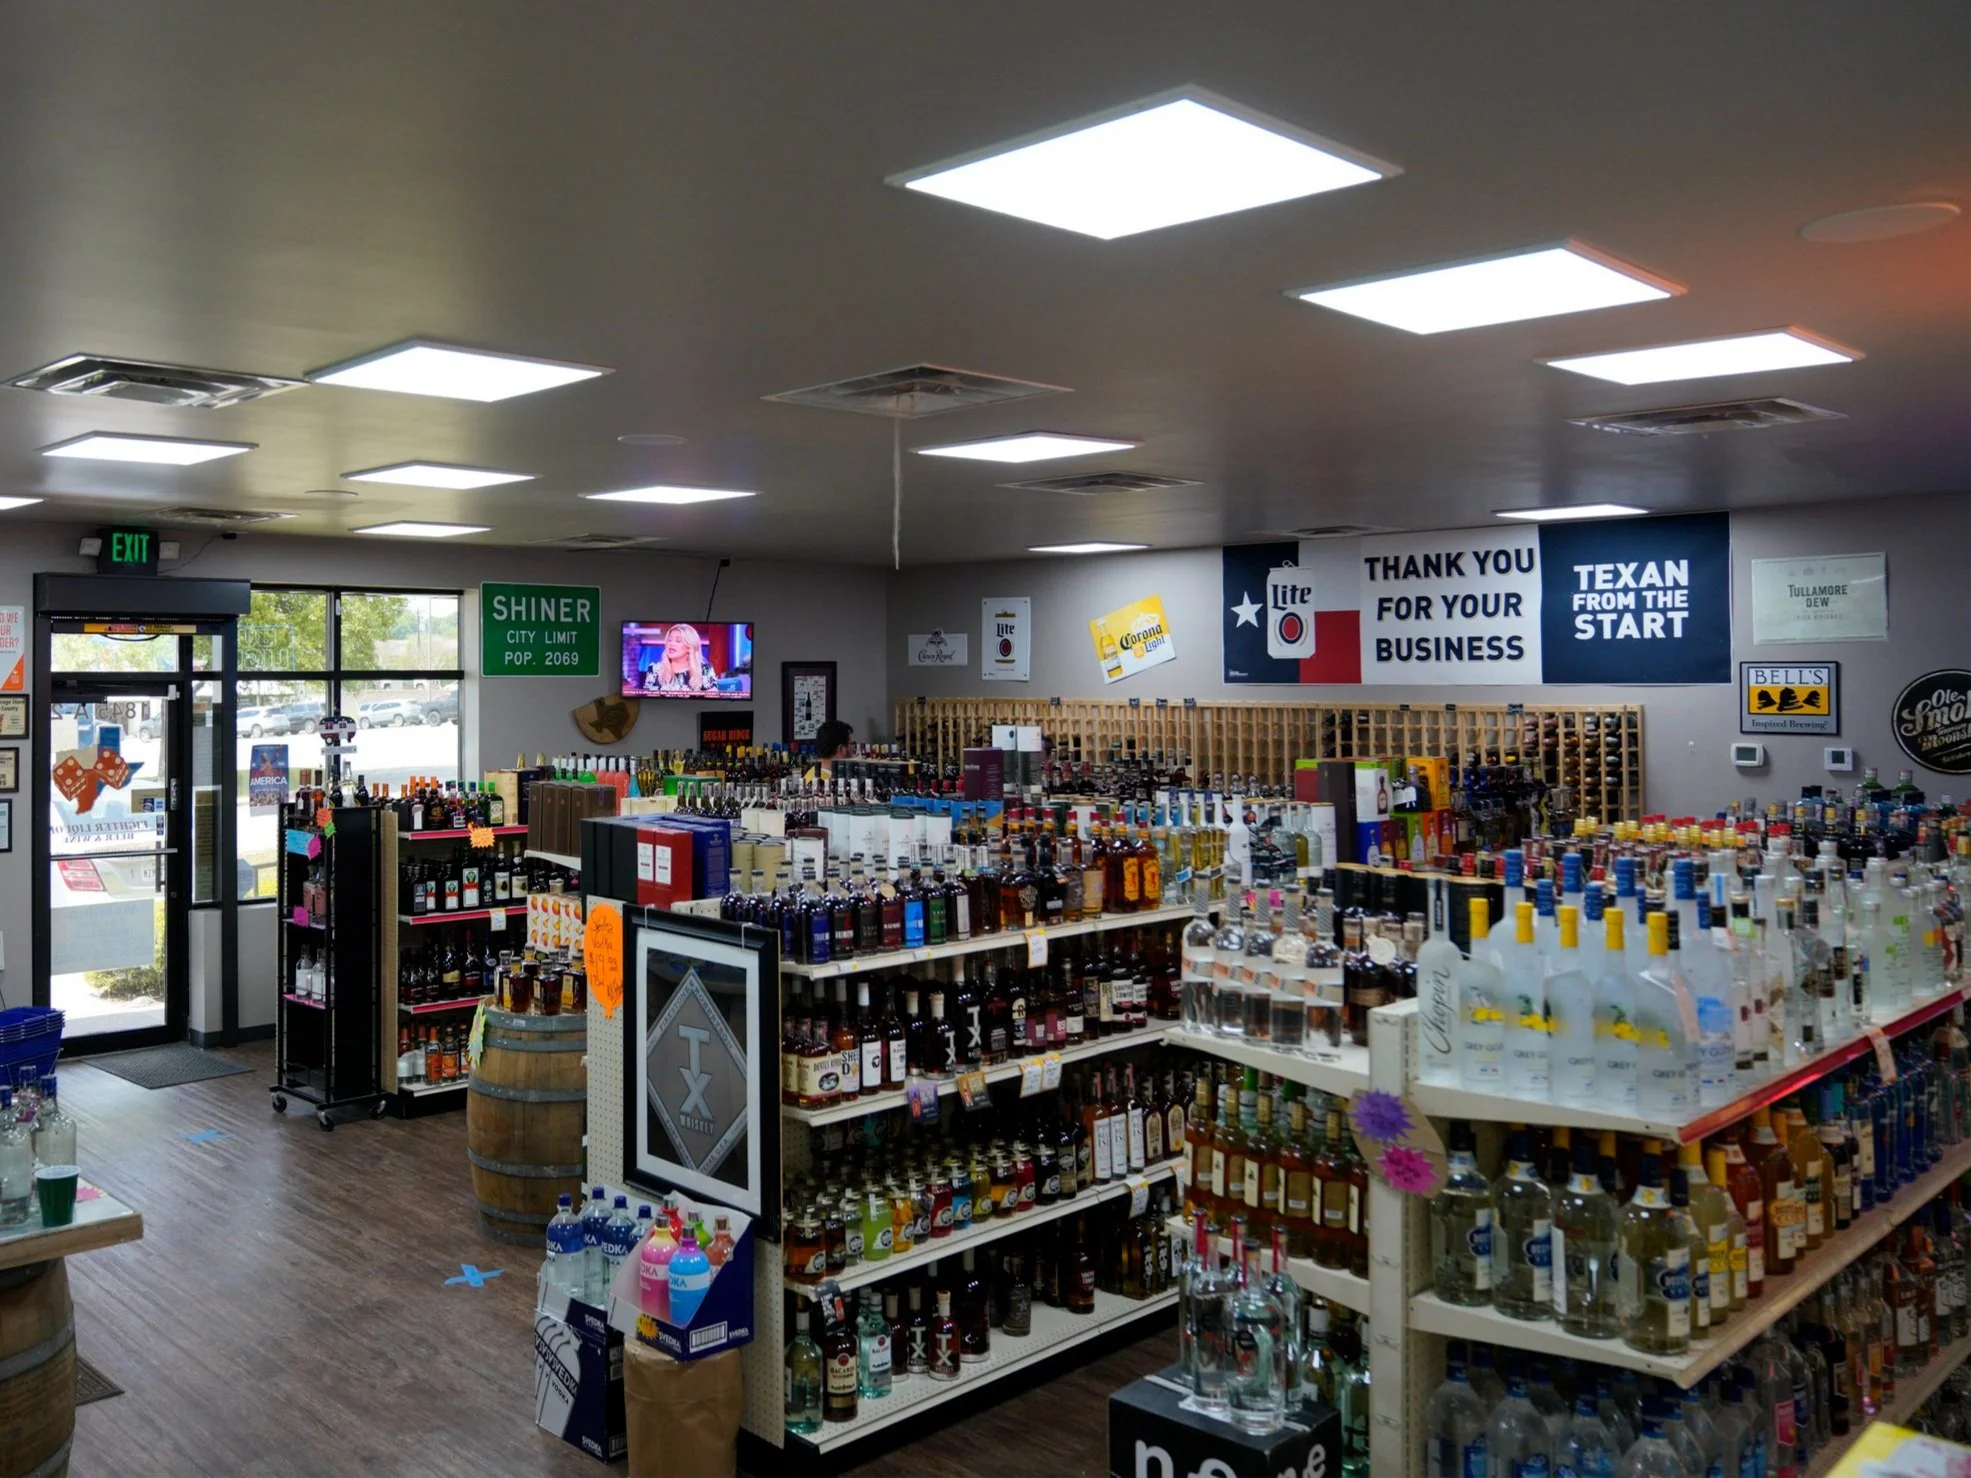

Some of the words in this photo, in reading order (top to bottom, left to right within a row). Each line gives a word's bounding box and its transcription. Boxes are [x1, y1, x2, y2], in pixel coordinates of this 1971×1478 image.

[112, 533, 149, 563] EXIT
[1365, 551, 1465, 581] THANK
[1473, 547, 1535, 575] YOU
[1573, 559, 1689, 590] TEXAN
[1271, 584, 1312, 611] Lite
[1573, 591, 1636, 611] FROM
[1642, 589, 1689, 609] THE
[1787, 584, 1848, 598] TULLAMORE
[1806, 597, 1829, 607] DEW
[493, 595, 591, 623] SHINER
[1377, 595, 1433, 621] FOR
[1441, 592, 1522, 618] YOUR
[996, 623, 1015, 637] Lite
[1574, 610, 1689, 640] START
[507, 630, 535, 644] CITY
[545, 631, 577, 645] LIMIT
[1120, 624, 1163, 650] Corona
[1144, 636, 1166, 653] Light
[505, 651, 536, 666] POP.
[545, 651, 579, 666] 2069
[1376, 635, 1524, 662] BUSINESS
[1755, 669, 1824, 685] BELL'S
[1932, 689, 1966, 707] Ole
[1752, 719, 1786, 729] Inspired
[1789, 719, 1826, 730] Brewing
[250, 776, 287, 786] AMERICA
[1421, 966, 1457, 1054] Chopin
[680, 1114, 716, 1136] WHISKEY
[659, 1331, 681, 1349] SVEDKA
[936, 1333, 953, 1366] TX
